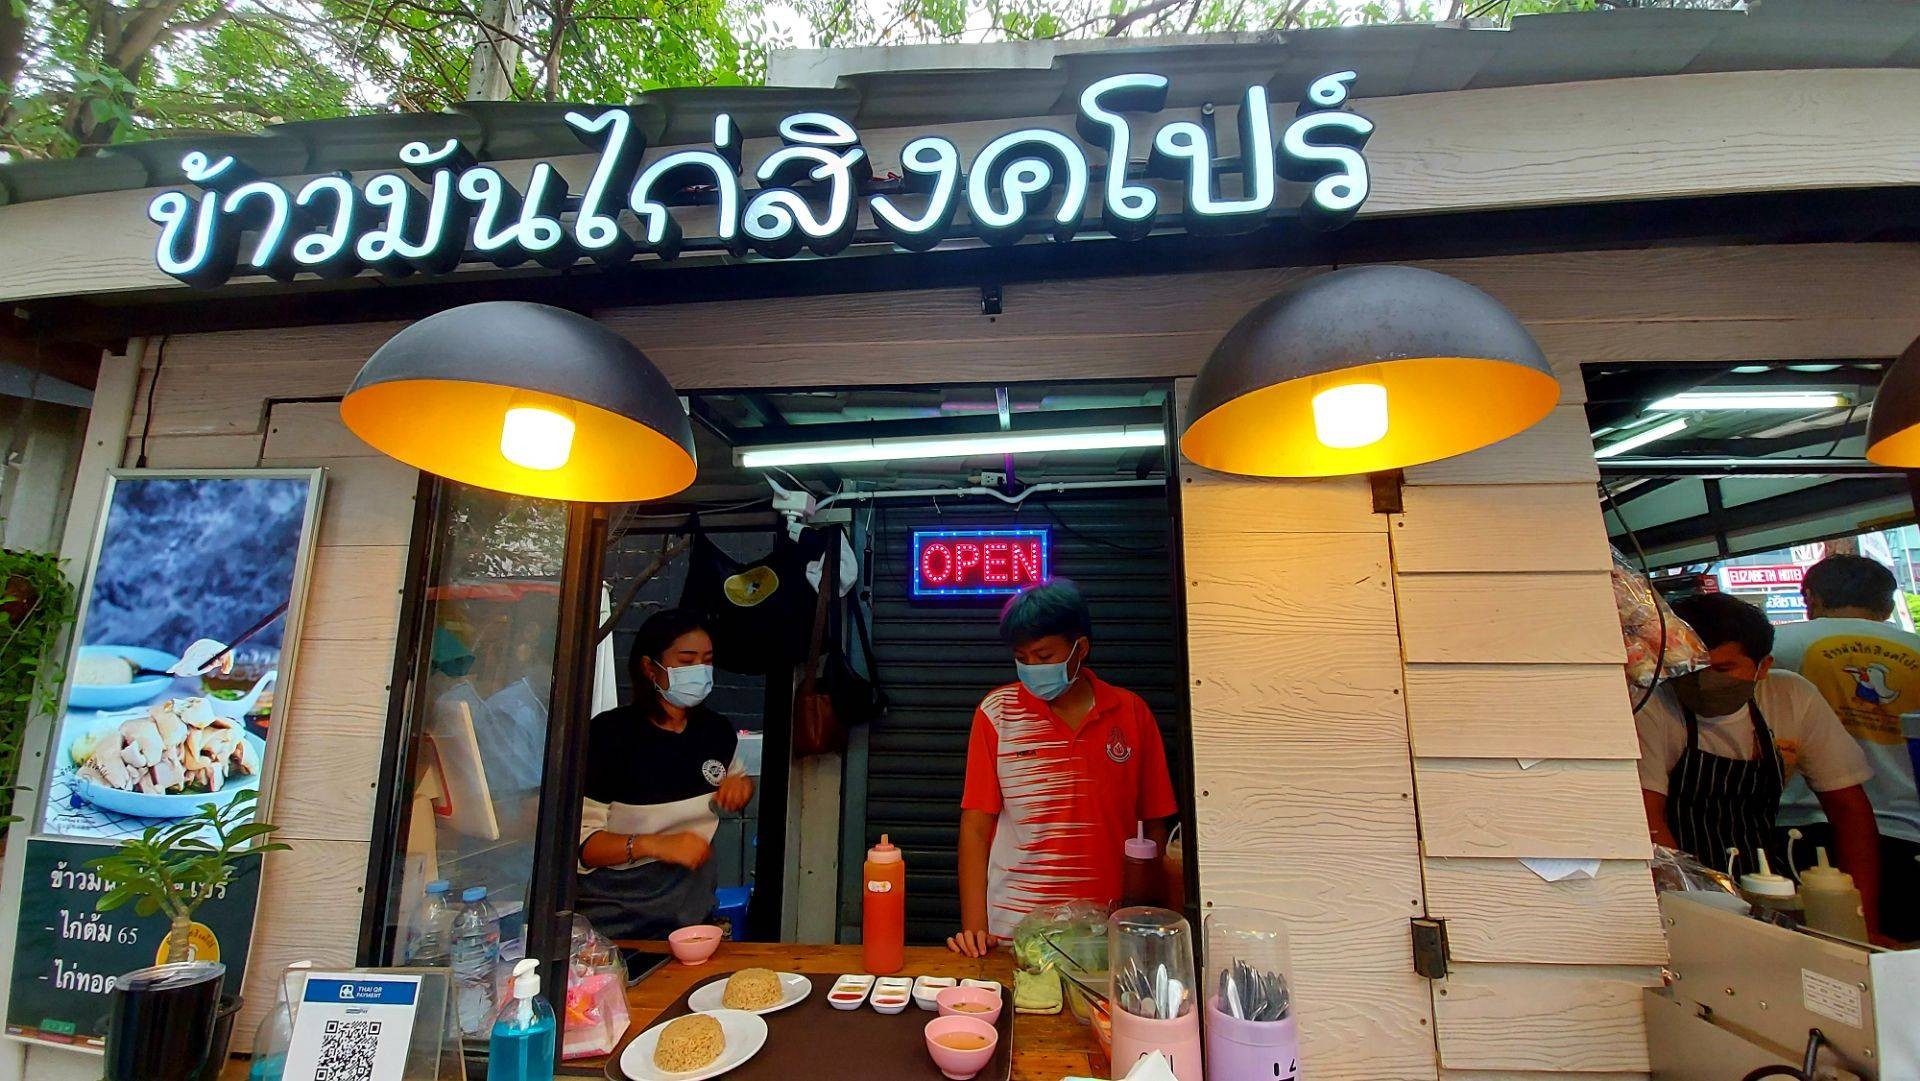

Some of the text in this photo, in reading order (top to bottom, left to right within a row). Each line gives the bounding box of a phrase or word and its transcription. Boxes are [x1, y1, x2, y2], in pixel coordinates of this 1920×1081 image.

[148, 69, 1375, 276] ข้าวมันไก่สิงคโปร์
[922, 543, 1038, 582] OPEN
[1729, 569, 1777, 583] ELIZABETH
[60, 909, 113, 943] ไก่ต้ม
[117, 926, 139, 945] 65
